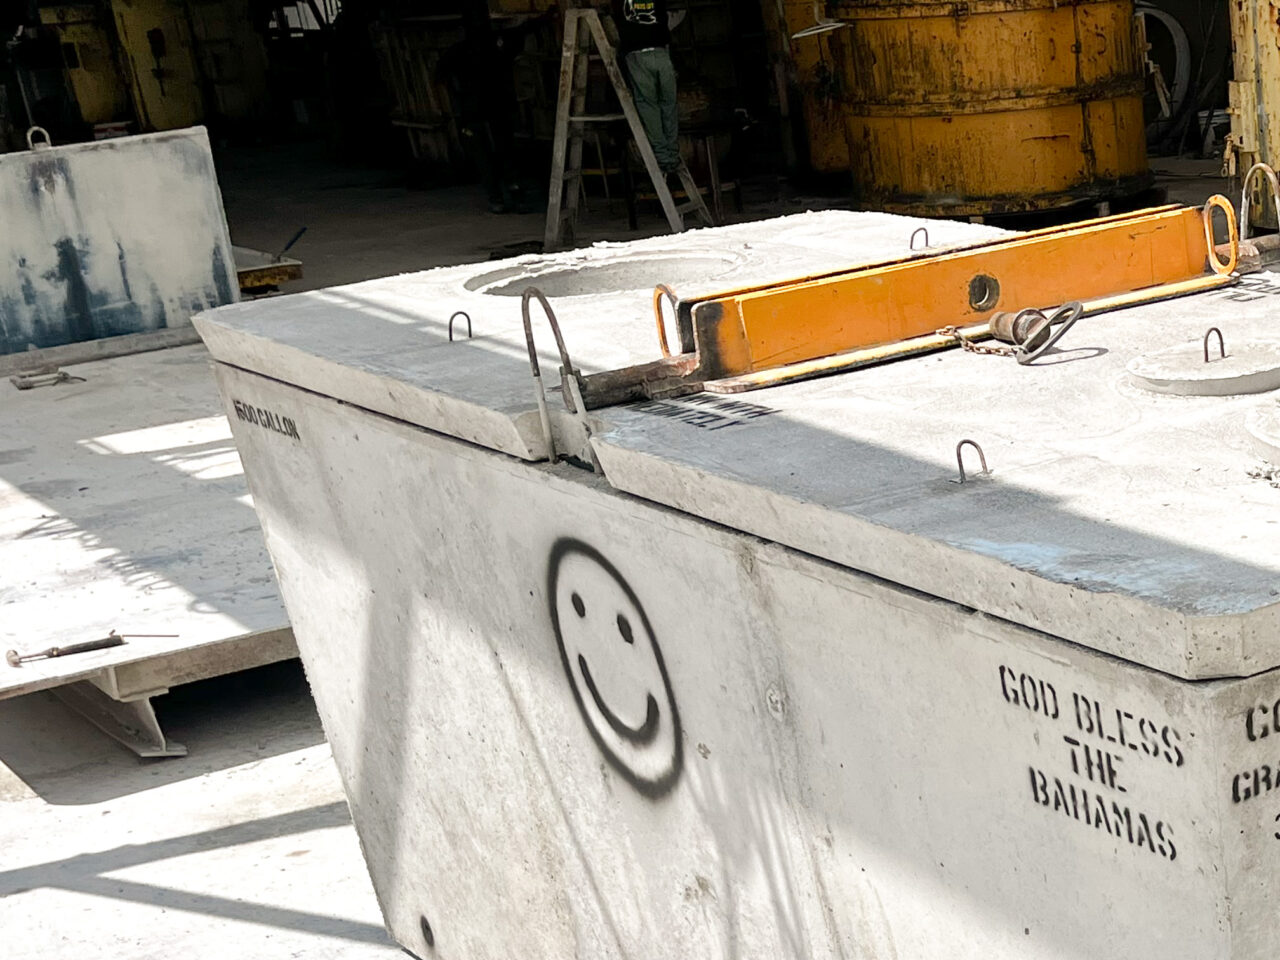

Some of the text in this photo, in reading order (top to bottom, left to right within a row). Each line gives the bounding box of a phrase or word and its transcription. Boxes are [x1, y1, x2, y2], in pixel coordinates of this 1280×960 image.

[257, 408, 301, 441] GALLON
[999, 665, 1185, 767] GOD BLESS
[1063, 735, 1127, 792] THE
[1029, 766, 1176, 860] BAHAMAS
